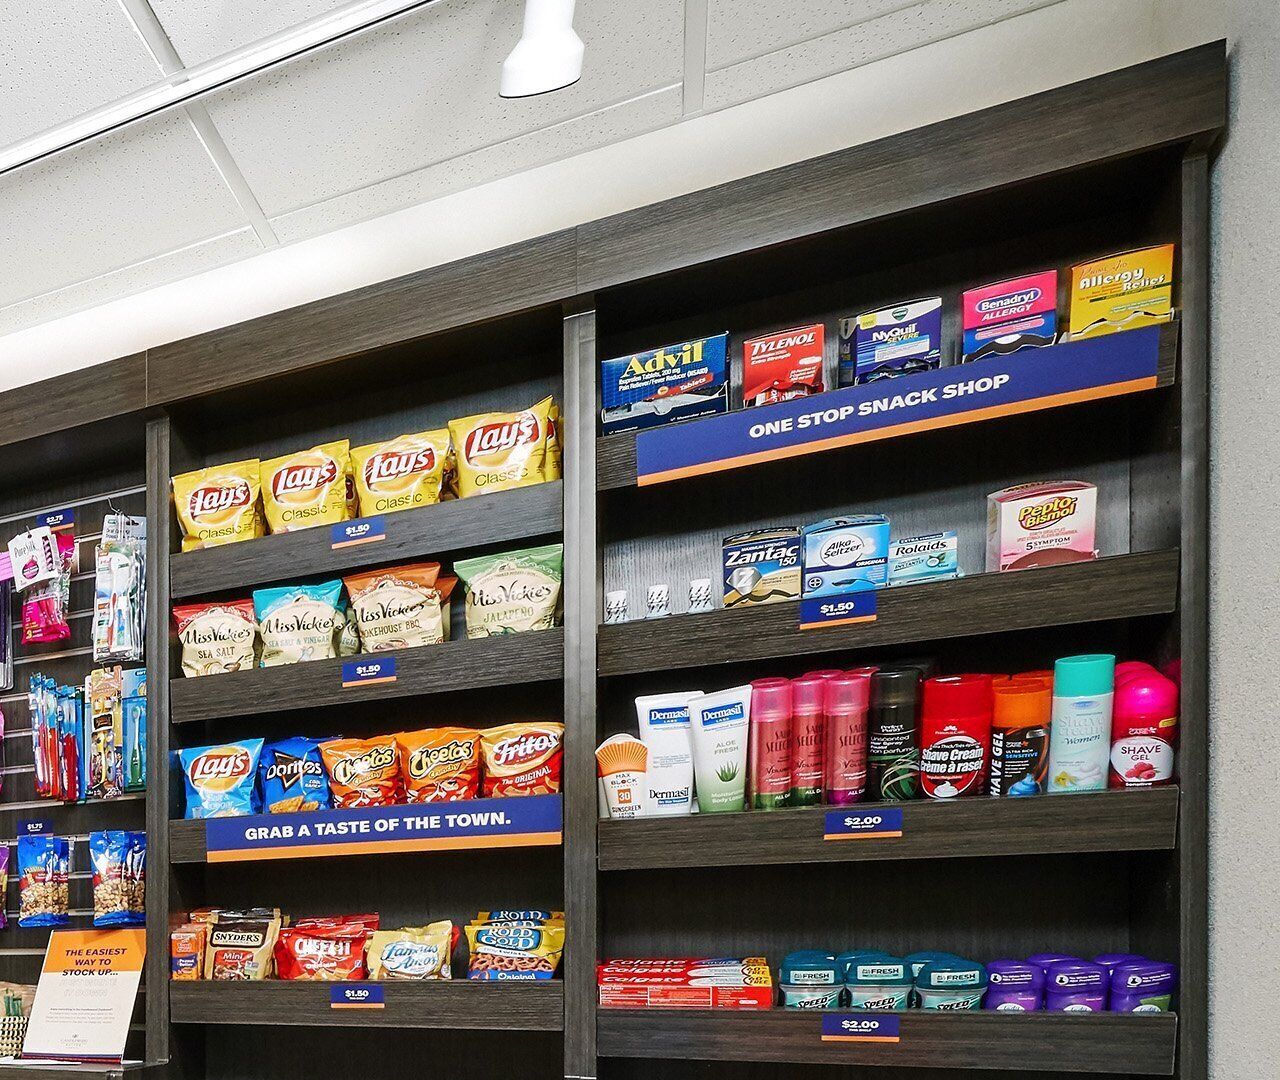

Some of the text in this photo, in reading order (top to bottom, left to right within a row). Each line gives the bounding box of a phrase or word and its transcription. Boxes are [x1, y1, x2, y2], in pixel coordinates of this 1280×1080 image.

[1079, 268, 1144, 290] Allergy
[1122, 275, 1166, 292] Relief
[981, 291, 1034, 311] Benadryl
[981, 303, 1033, 321] ALLERGY
[872, 323, 918, 343] NyQuil
[751, 332, 817, 357] TYLENOL
[619, 341, 705, 379] Advil
[749, 374, 1010, 439] ONE STOP SNACK SHOP
[282, 504, 327, 522] Classic
[1019, 496, 1078, 521] Pepto-
[1025, 503, 1076, 528] Bismol
[345, 523, 370, 535] $1.50
[823, 544, 862, 559] Seltzer
[828, 539, 856, 551] Alka-
[896, 540, 947, 556] Rolaids
[1026, 537, 1071, 551] 5 SYMPTOM
[726, 546, 799, 567] Zantac
[779, 556, 797, 566] 150
[856, 558, 885, 567] ORIGINAL
[820, 602, 855, 613] $1.50
[198, 647, 236, 659] SEA SALT
[356, 664, 381, 675] $1.50
[702, 705, 743, 721] Dermasil
[493, 729, 559, 765] Fritos
[922, 747, 984, 760] Shave Cream
[1121, 745, 1162, 754] SHAVE
[409, 739, 474, 778] Cheetos
[266, 761, 323, 781] Doritos
[921, 759, 984, 774] Crème à raser
[502, 766, 552, 786] The ORIGINAL
[245, 812, 512, 840] GRAB A TASTE OF THE TOWN.
[844, 816, 882, 826] $2.00
[214, 933, 260, 942] SNYDER'S
[481, 937, 534, 949] GOLD
[802, 972, 830, 980] FRESH
[871, 968, 900, 976] FRESH
[947, 973, 976, 981] FRESH
[841, 1020, 879, 1030] $2.00
